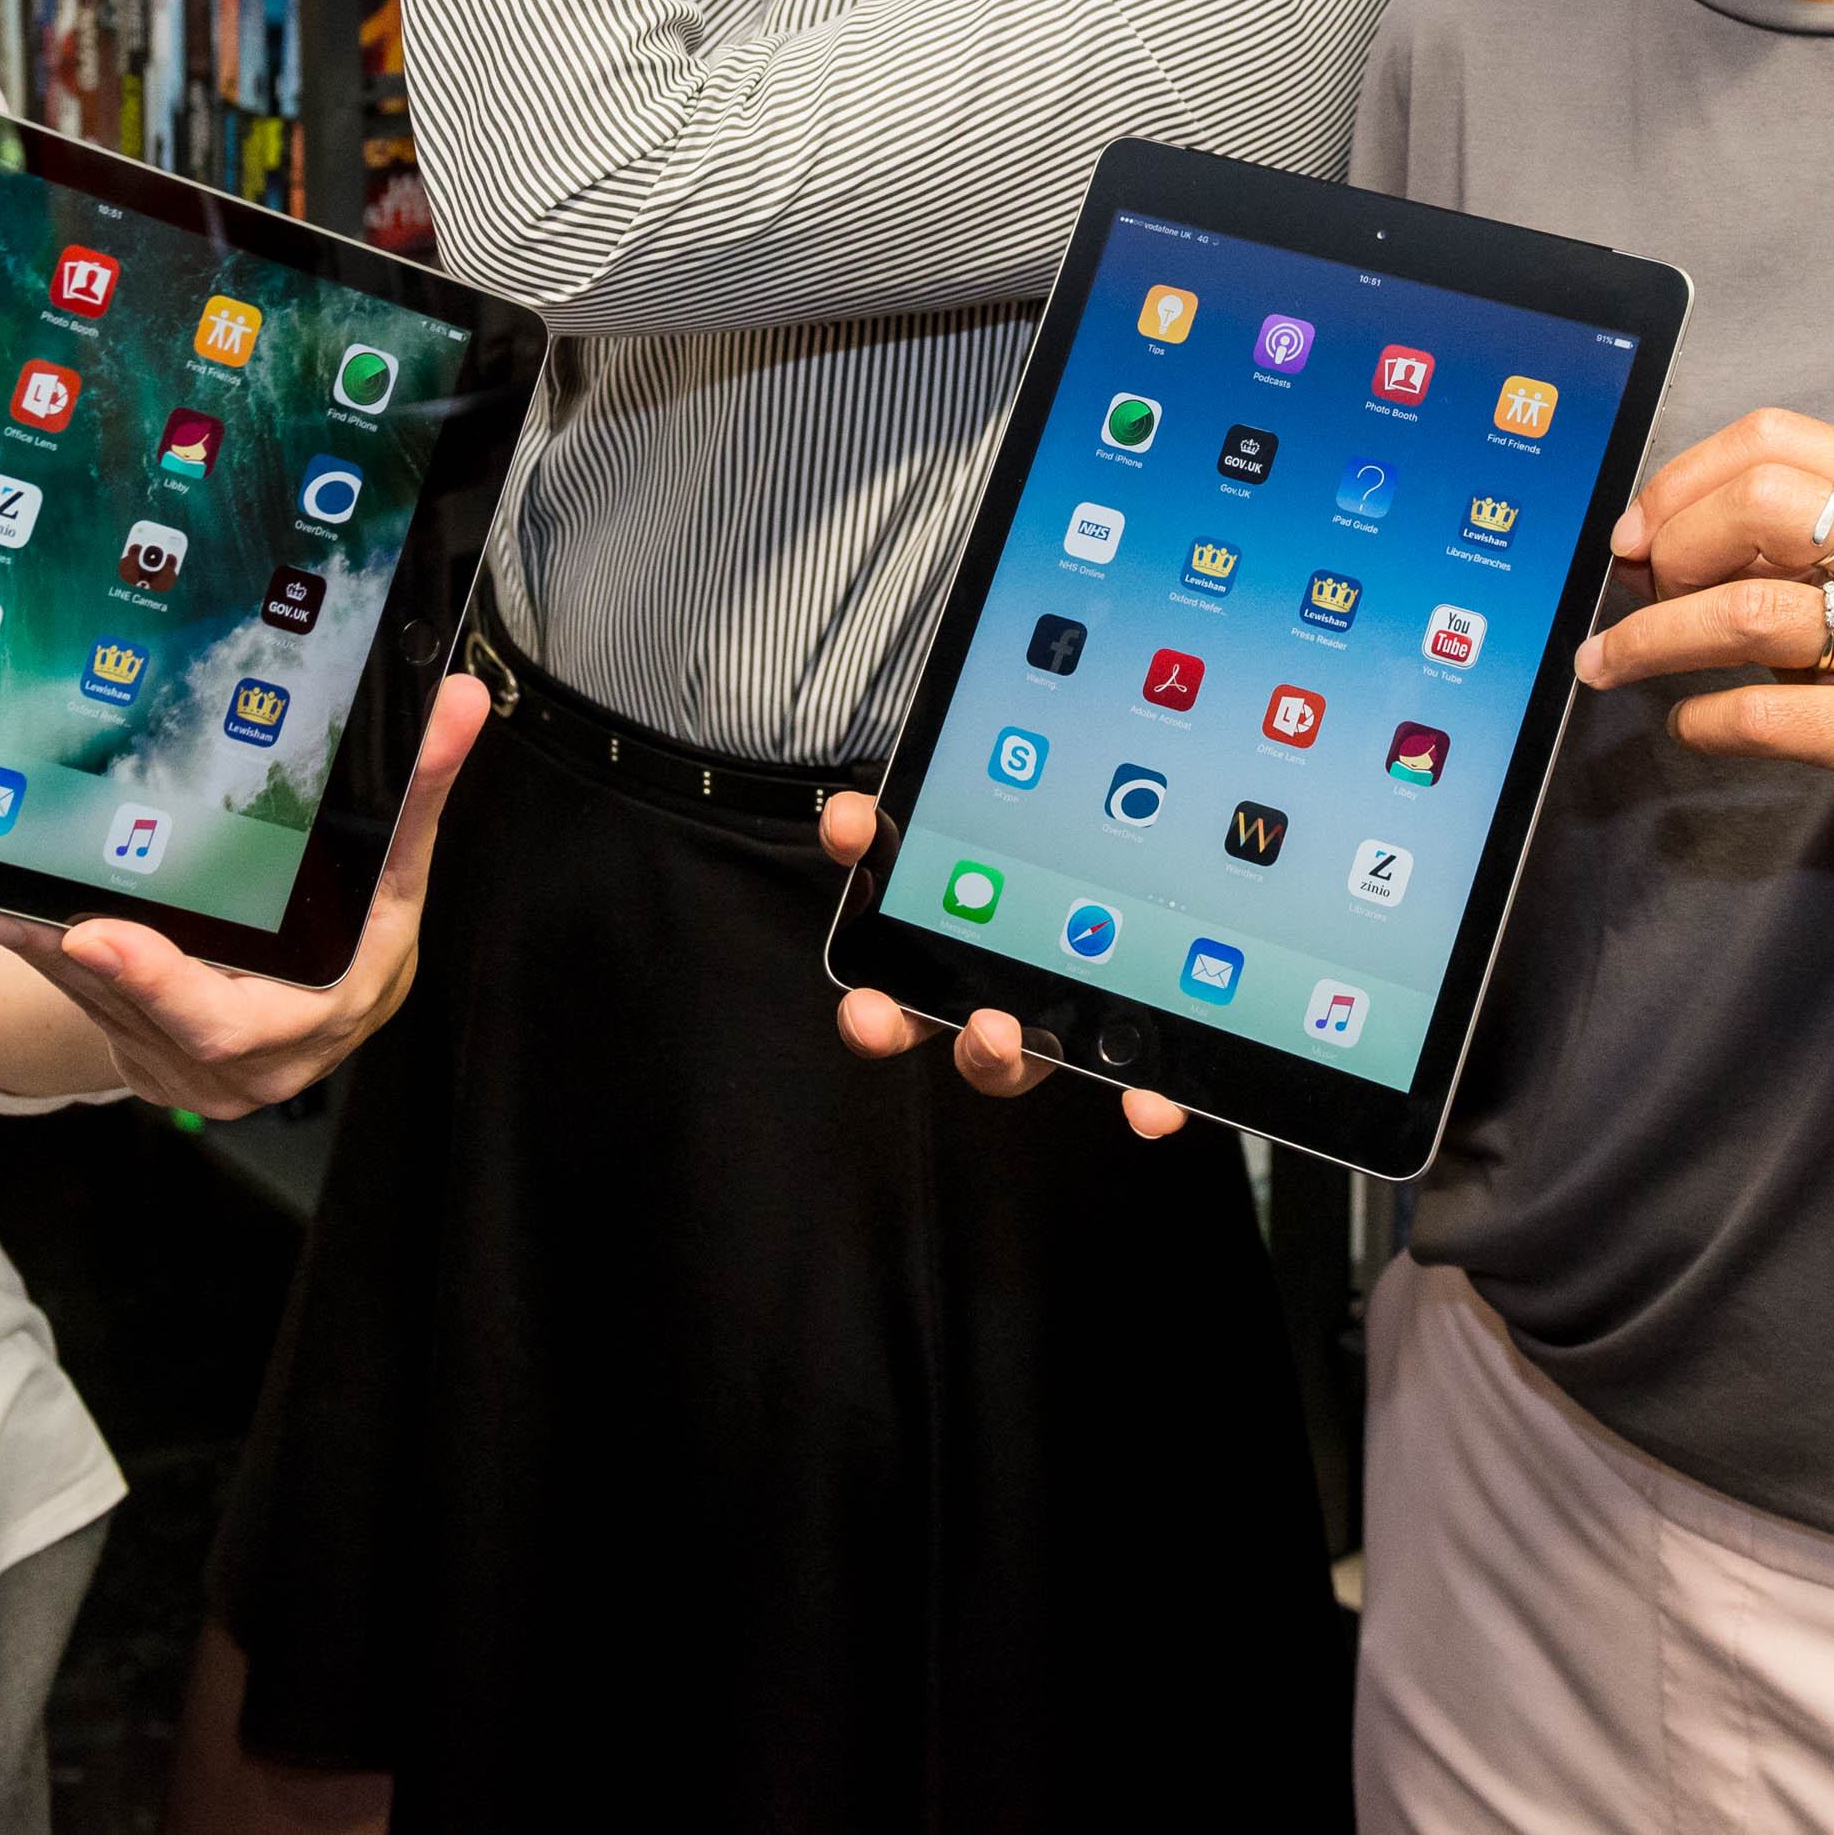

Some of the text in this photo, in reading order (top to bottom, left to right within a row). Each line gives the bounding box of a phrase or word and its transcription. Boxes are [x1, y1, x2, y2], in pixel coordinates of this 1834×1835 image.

[97, 204, 123, 220] 10:51
[1144, 220, 1209, 244] vodafone UK 4G
[1359, 273, 1382, 287] 10:51
[40, 310, 100, 339] Photo Booth
[1596, 333, 1613, 345] 91%
[1148, 343, 1165, 356] Tips
[185, 359, 242, 387] Find Friends
[1253, 371, 1292, 389] Podcasts
[326, 408, 378, 433] Find iPhone
[1365, 401, 1418, 422] Photo Booth
[3, 426, 58, 452] Office Lens
[1487, 433, 1542, 455] Find Friends
[1095, 449, 1143, 469] Find iPhone
[1224, 455, 1263, 474] GOV.UK
[163, 478, 190, 494] Libby
[1220, 483, 1251, 499] Gov.UK
[294, 519, 338, 542] OverDrive
[1079, 521, 1110, 540] NHS
[1332, 514, 1379, 535] iPad Guide
[1463, 528, 1508, 548] Lewisham
[1446, 545, 1512, 572] Library Branches
[1079, 565, 1105, 580] Online
[1185, 574, 1227, 593] Lewisham
[108, 586, 168, 612] LINE Camera
[1168, 591, 1198, 609] Oxford
[268, 601, 310, 623] GOV.UK
[1304, 608, 1348, 629] Lewisham
[1291, 626, 1348, 651] Press Reader
[1435, 611, 1470, 659] You Tube
[1422, 666, 1463, 684] You Tube
[84, 681, 132, 702] Lewisham
[228, 721, 274, 743] Lewisham
[1392, 785, 1417, 801] Libby
[1359, 879, 1391, 898] zinio
